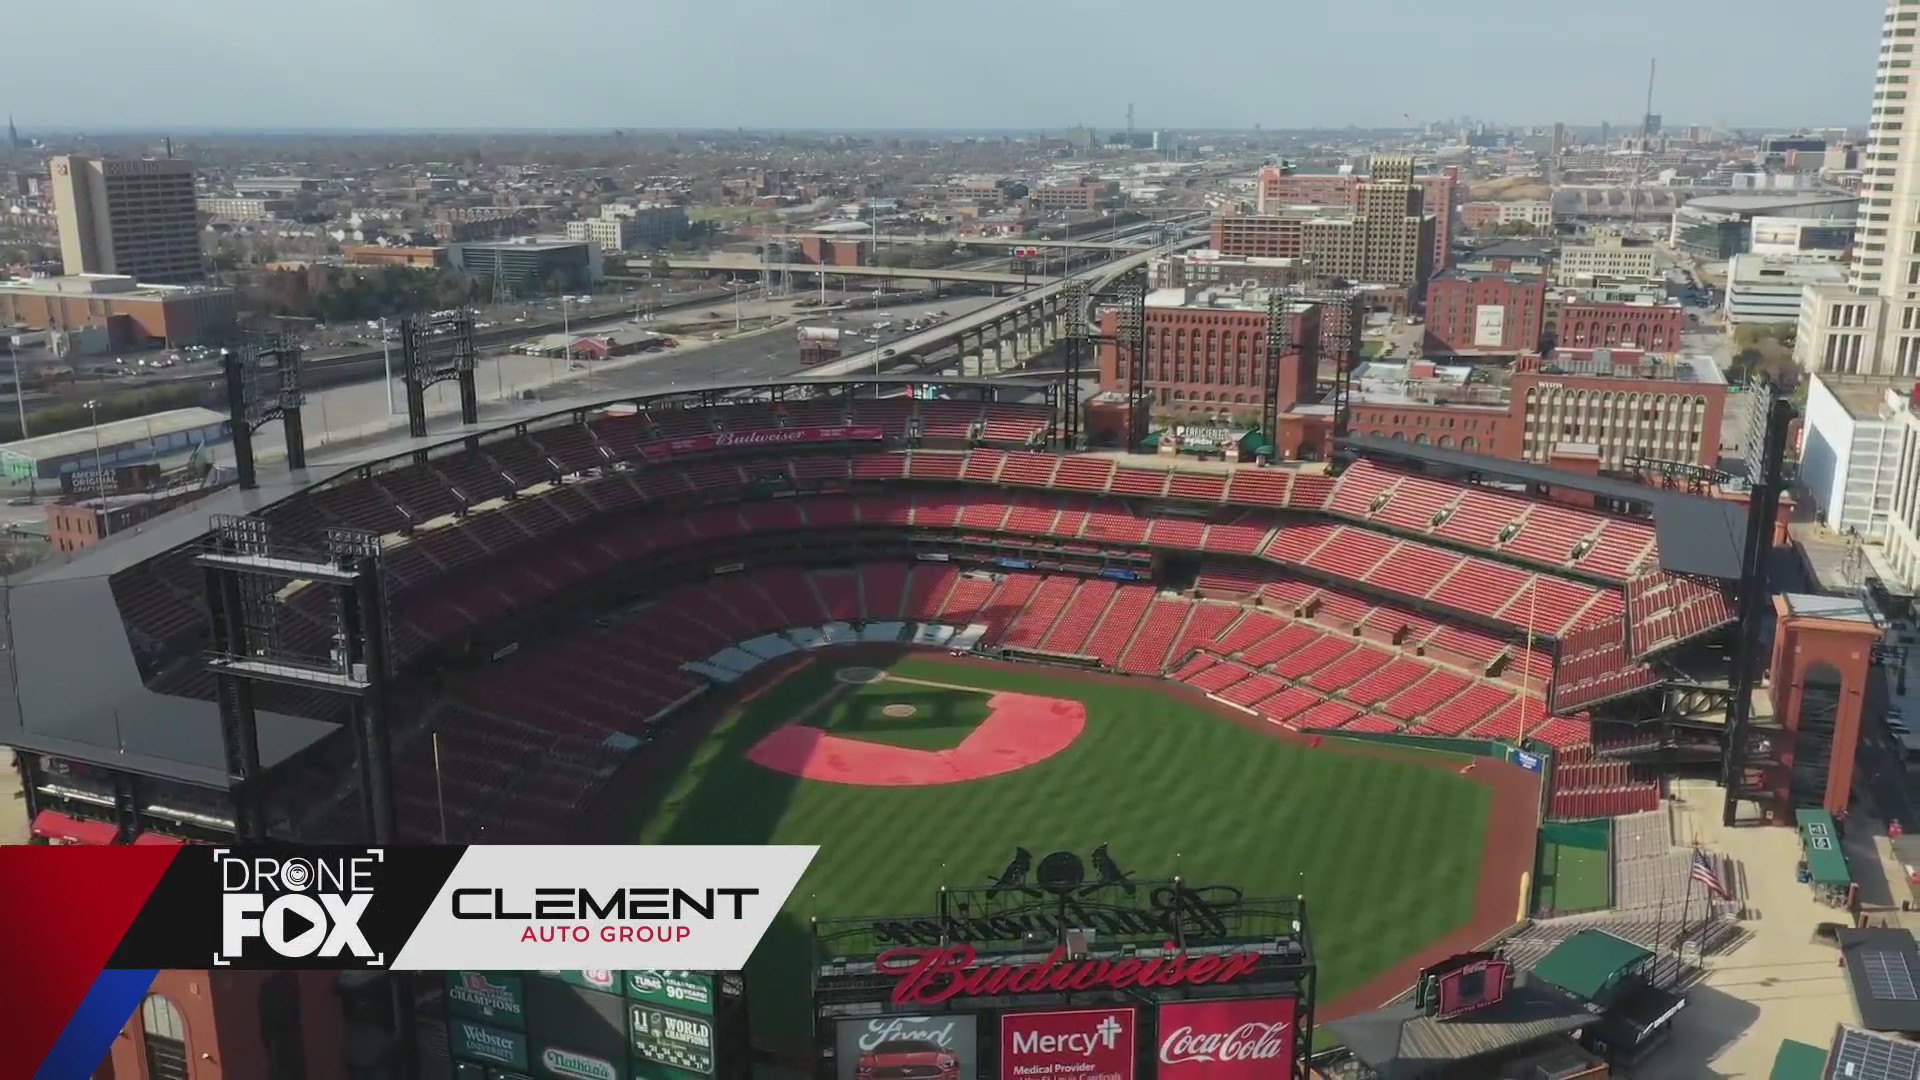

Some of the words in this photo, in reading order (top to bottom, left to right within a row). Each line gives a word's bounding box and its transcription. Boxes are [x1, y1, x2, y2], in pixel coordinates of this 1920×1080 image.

[709, 430, 807, 447] Budweiser
[875, 942, 1262, 1006] Budweiser
[449, 988, 520, 1014] CHAMPIONS
[666, 985, 684, 1000] 90
[633, 1010, 647, 1027] 11
[664, 1017, 709, 1037] WORLD
[463, 1024, 514, 1050] Webster
[664, 1029, 710, 1047] CHAMPIONS
[858, 1016, 954, 1051] Ford
[1013, 1030, 1100, 1056] Mercy
[1159, 1021, 1290, 1064] Coca-Cola
[1013, 1064, 1053, 1075] Medical
[1055, 1062, 1096, 1073] Provider
